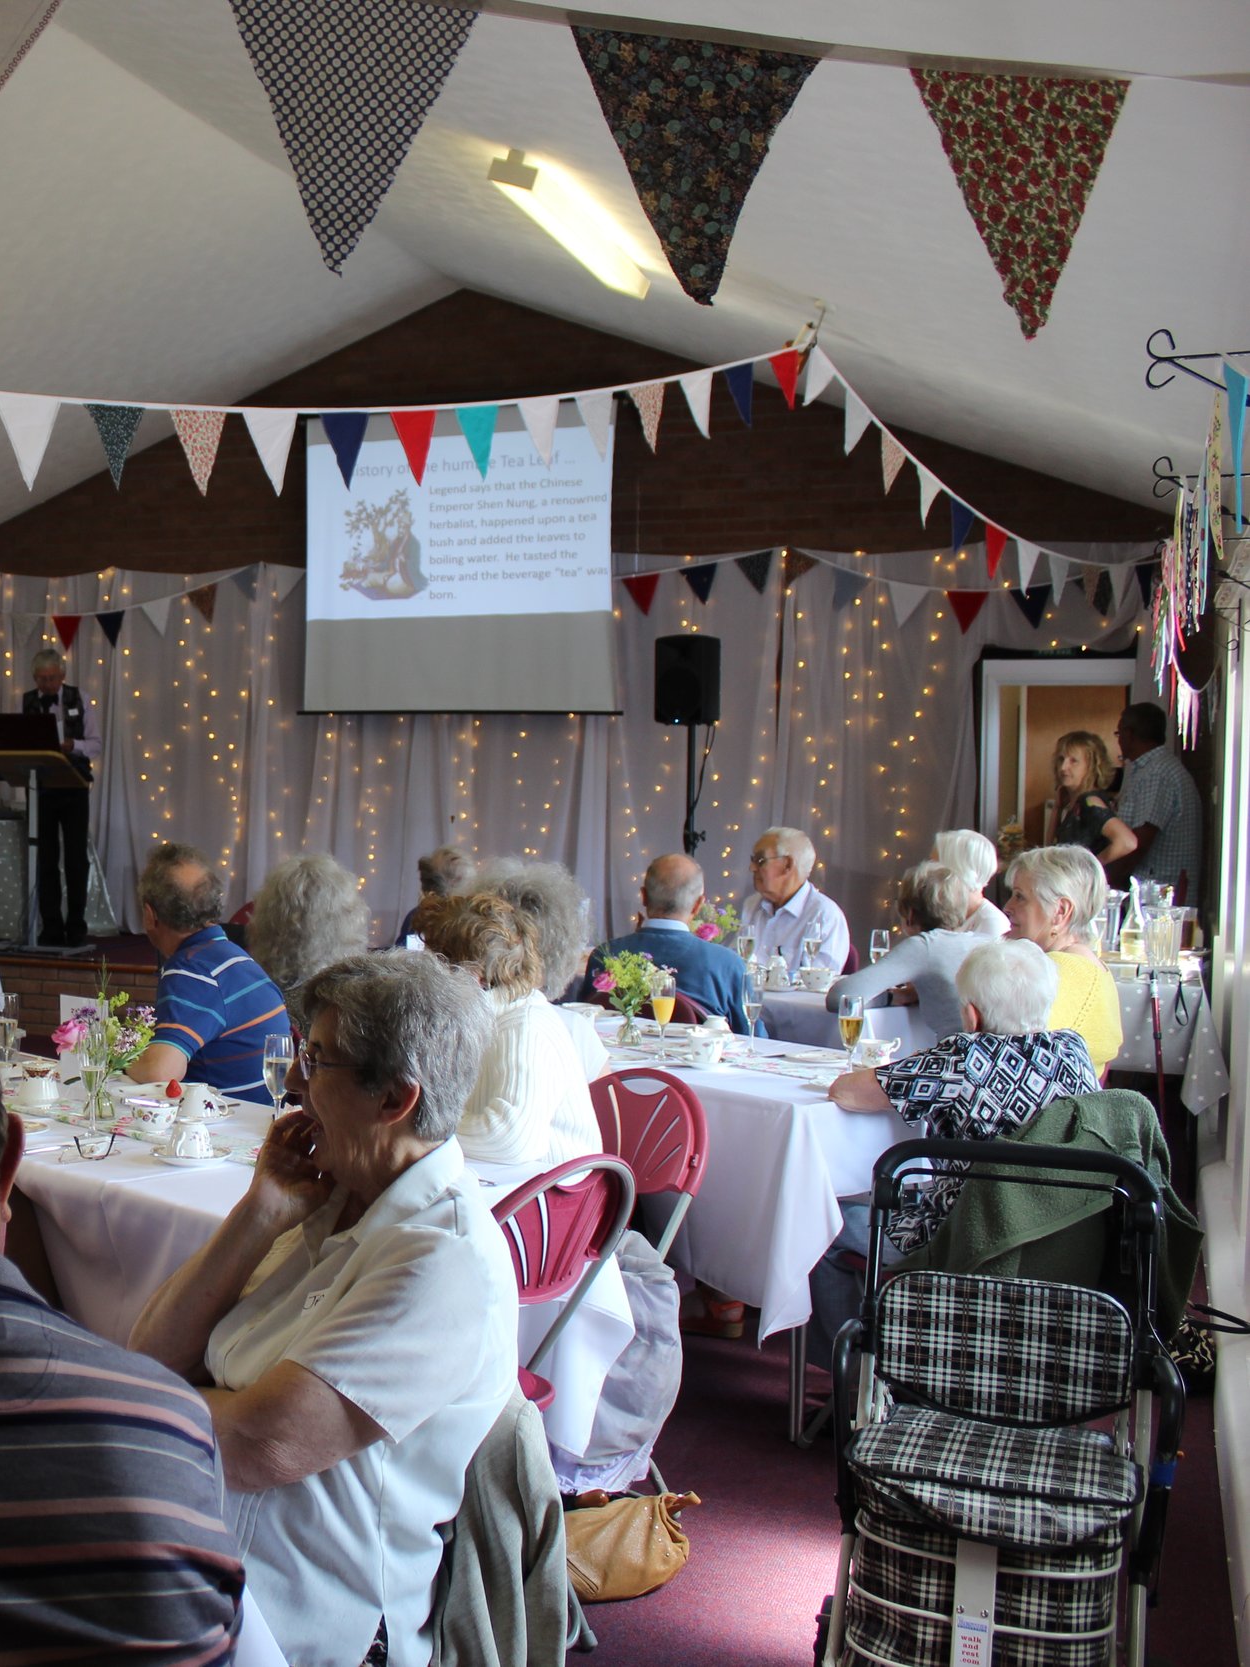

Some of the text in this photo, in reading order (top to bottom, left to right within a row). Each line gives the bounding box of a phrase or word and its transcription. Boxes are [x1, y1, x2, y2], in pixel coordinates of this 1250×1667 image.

[354, 462, 393, 478] istory
[442, 456, 496, 472] hume
[500, 454, 525, 468] Tea
[429, 478, 583, 497] Legend says that the Chinese
[429, 502, 474, 515] Emperor
[477, 499, 504, 510] Shen
[506, 498, 538, 510] Nung,
[550, 493, 608, 506] renowned
[429, 513, 597, 530] herbalist, happened upon a tea
[429, 531, 586, 548] bush and added the leaves to
[429, 549, 578, 566] boiling water. He tasted the
[429, 572, 455, 582] brew
[458, 571, 478, 581] and
[481, 570, 500, 580] the
[502, 568, 551, 581] beverage
[587, 567, 608, 576] was
[429, 590, 457, 600] born.
[961, 1635, 981, 1644] walk
[962, 1650, 979, 1658] rest
